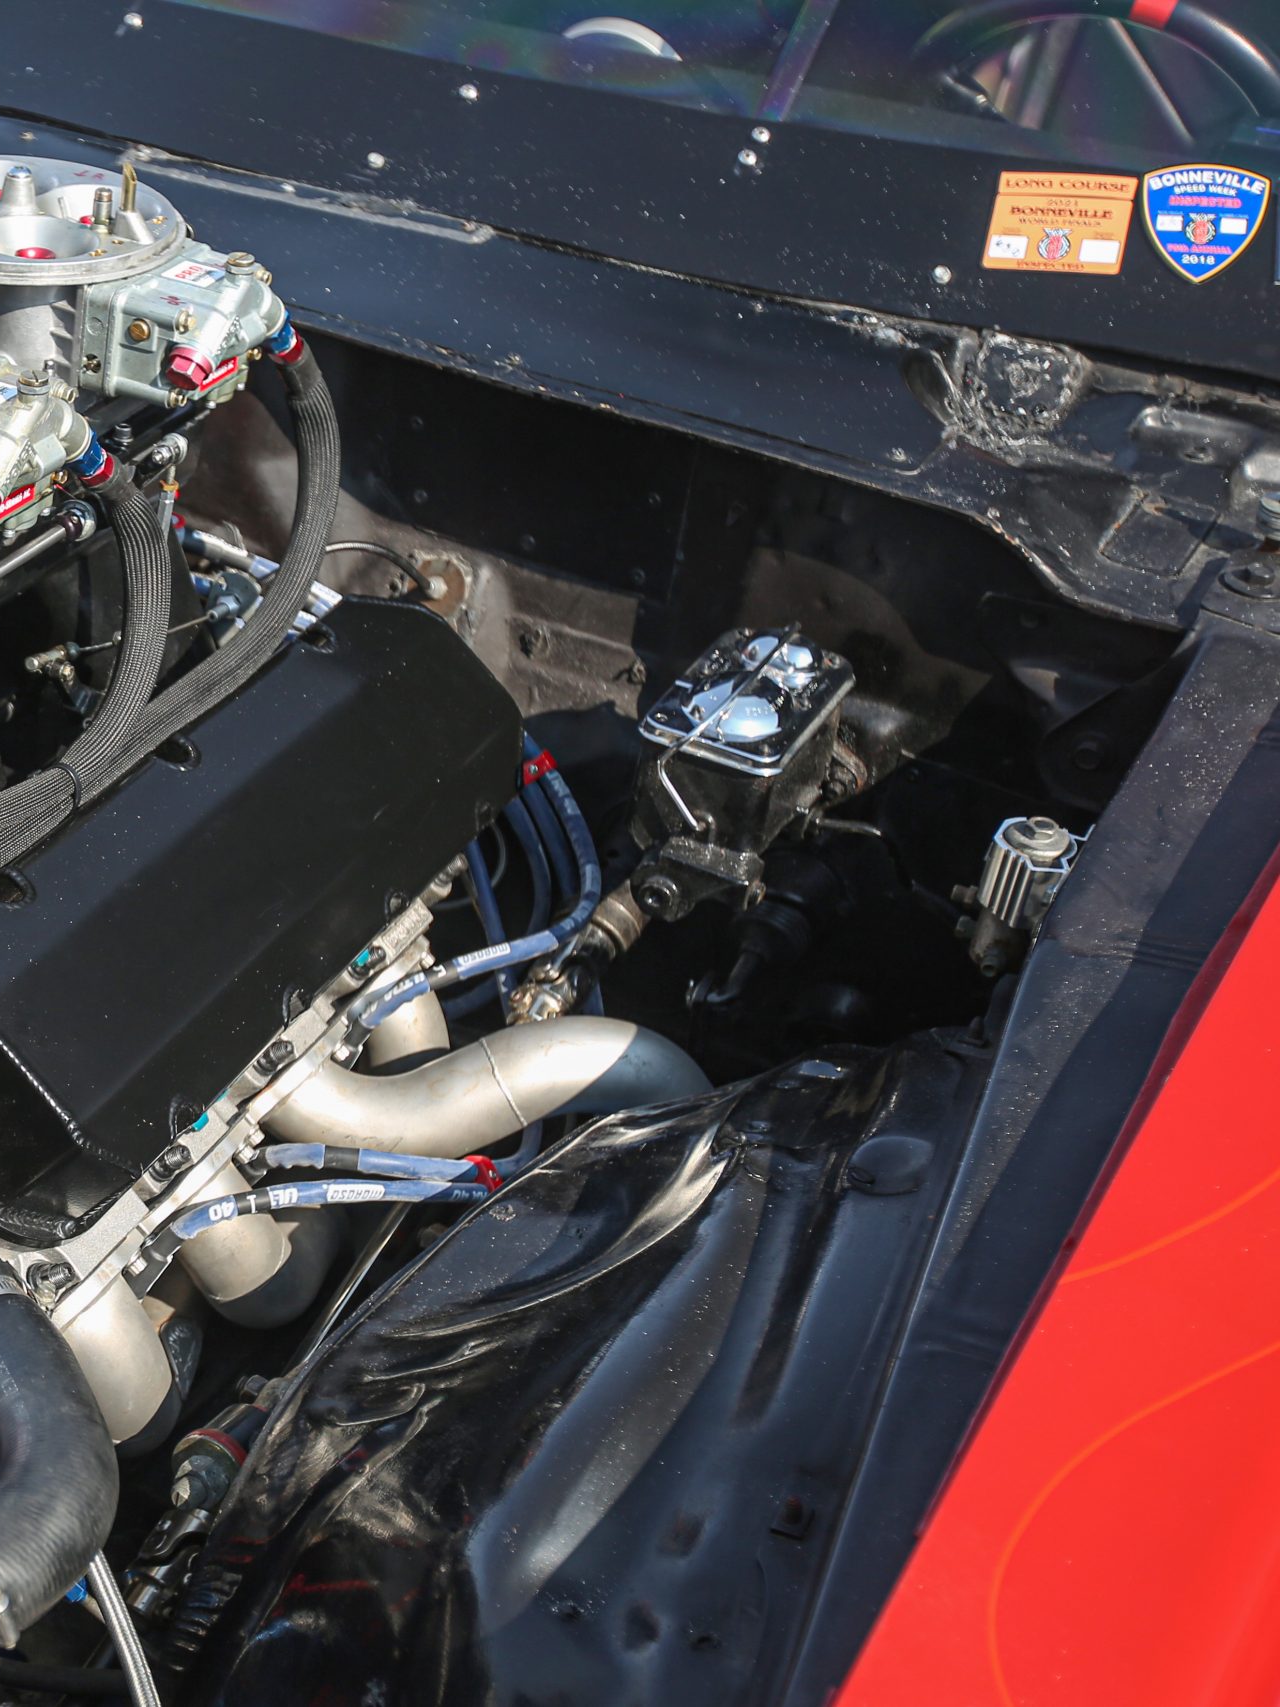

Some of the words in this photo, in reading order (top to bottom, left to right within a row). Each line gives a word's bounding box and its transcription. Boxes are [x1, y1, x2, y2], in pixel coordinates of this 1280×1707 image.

[1006, 178, 1053, 189] LONG
[1059, 179, 1130, 192] COURSE
[1148, 170, 1265, 195] BONNEVILLE
[1173, 183, 1206, 195] SPEED
[1208, 184, 1238, 197] WEEK
[1010, 206, 1114, 220] BONNEVILLE
[1181, 254, 1216, 265] 2018
[329, 1187, 385, 1201] MOROSO
[208, 1200, 236, 1222] 40
